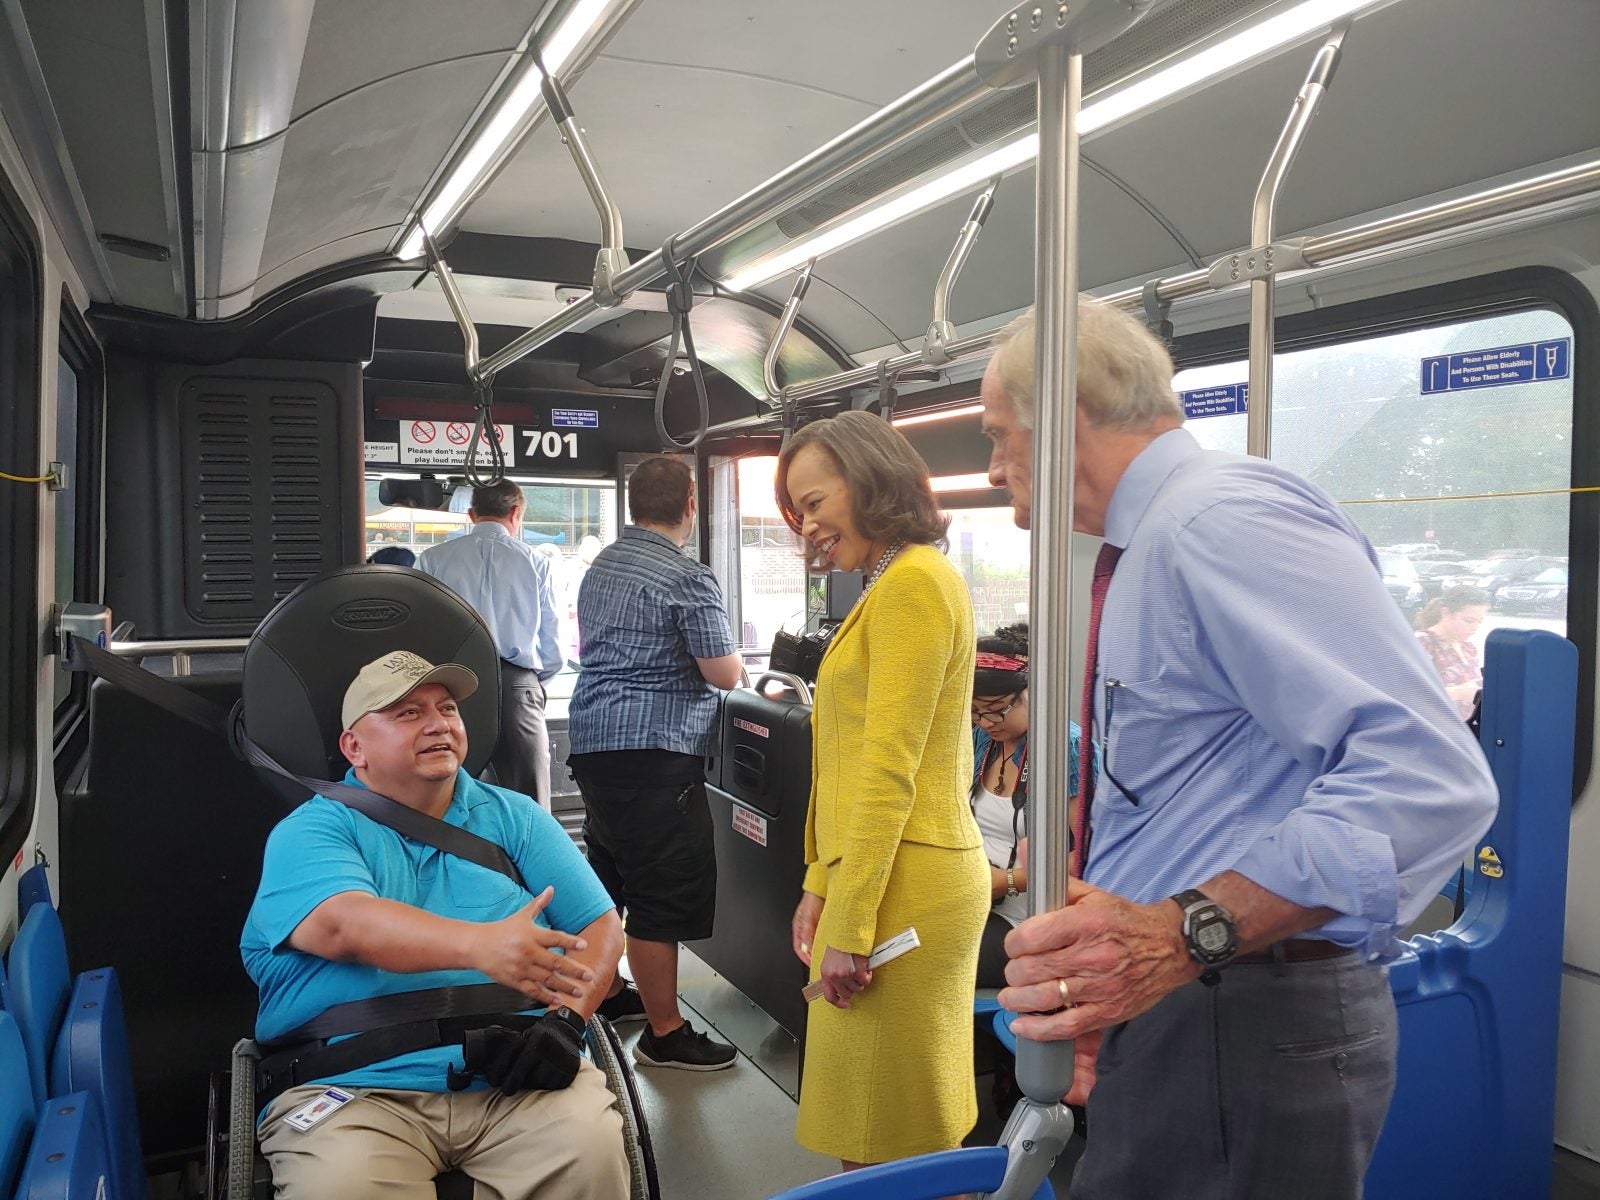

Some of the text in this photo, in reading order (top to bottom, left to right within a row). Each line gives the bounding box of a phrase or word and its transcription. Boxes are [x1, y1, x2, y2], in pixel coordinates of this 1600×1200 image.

[1462, 356, 1482, 364] Please
[1500, 351, 1520, 359] Elderly
[1451, 360, 1533, 375] And Persons With Disabilities
[1483, 373, 1499, 381] These
[1501, 371, 1519, 379] Seats.
[522, 430, 578, 459] 701
[414, 456, 430, 464] play
